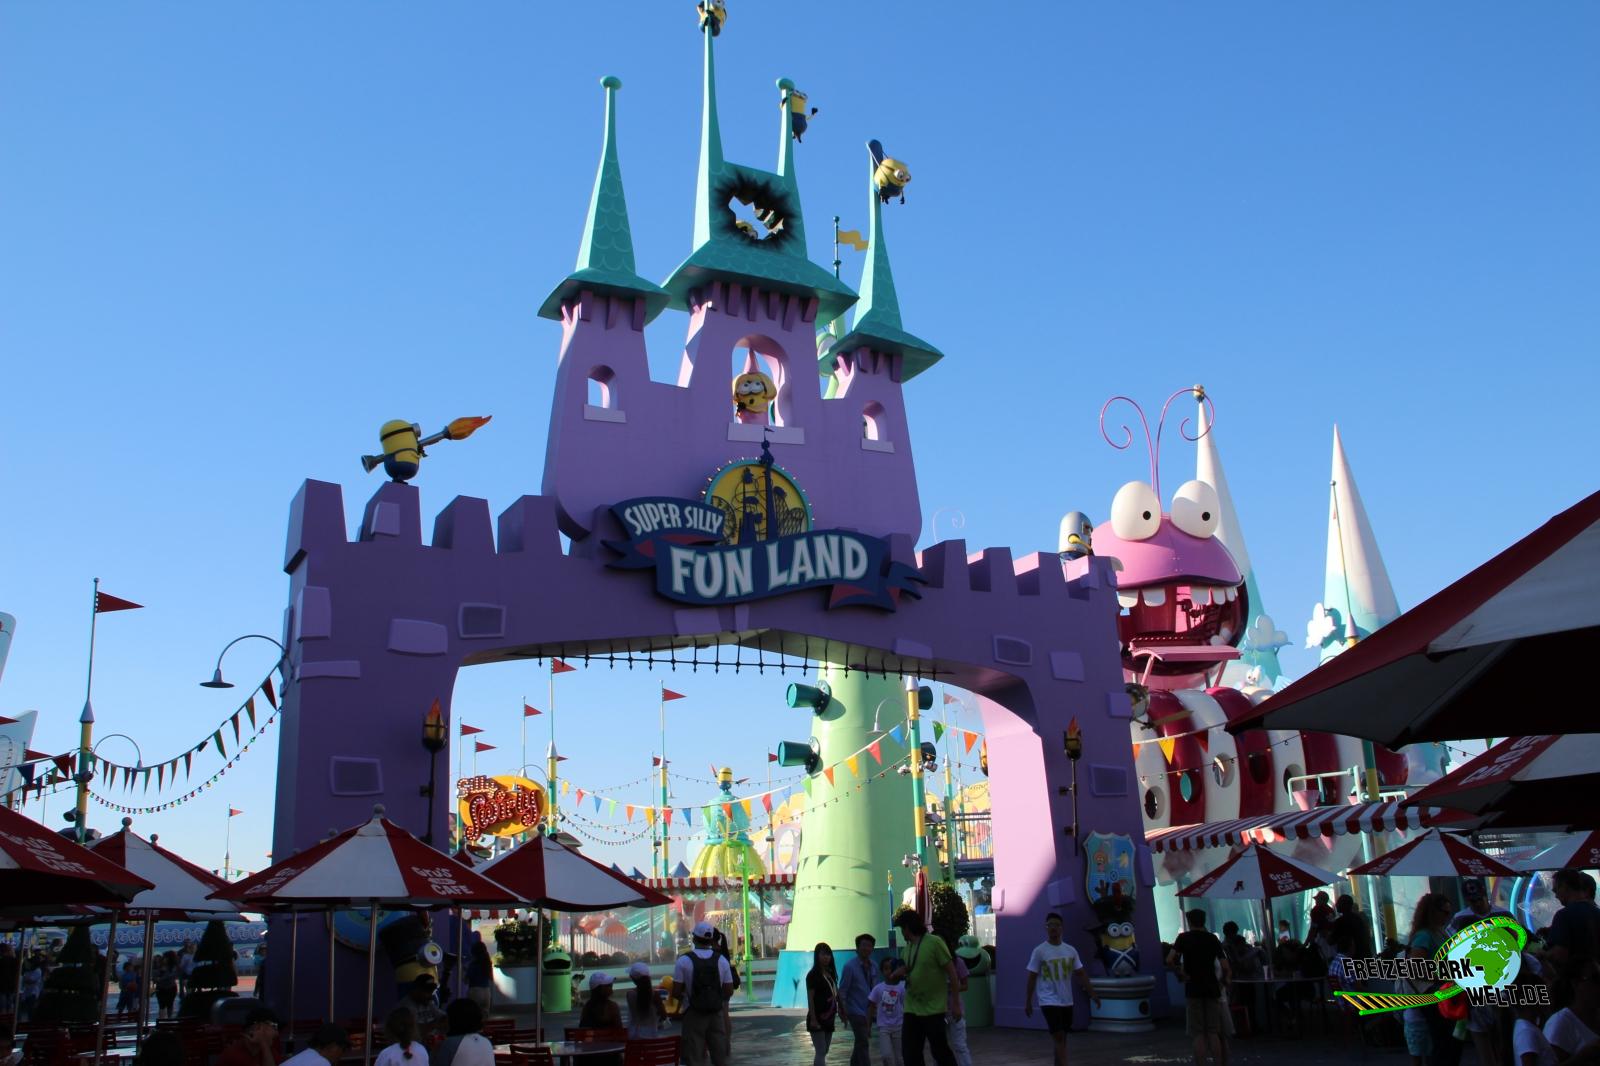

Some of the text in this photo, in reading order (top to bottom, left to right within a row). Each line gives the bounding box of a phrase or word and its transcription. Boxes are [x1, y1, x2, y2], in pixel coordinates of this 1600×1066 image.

[624, 503, 724, 535] SUPER SILLY
[670, 534, 869, 598] FUN LAND
[457, 775, 498, 799] Silly
[431, 884, 475, 896] CAFE
